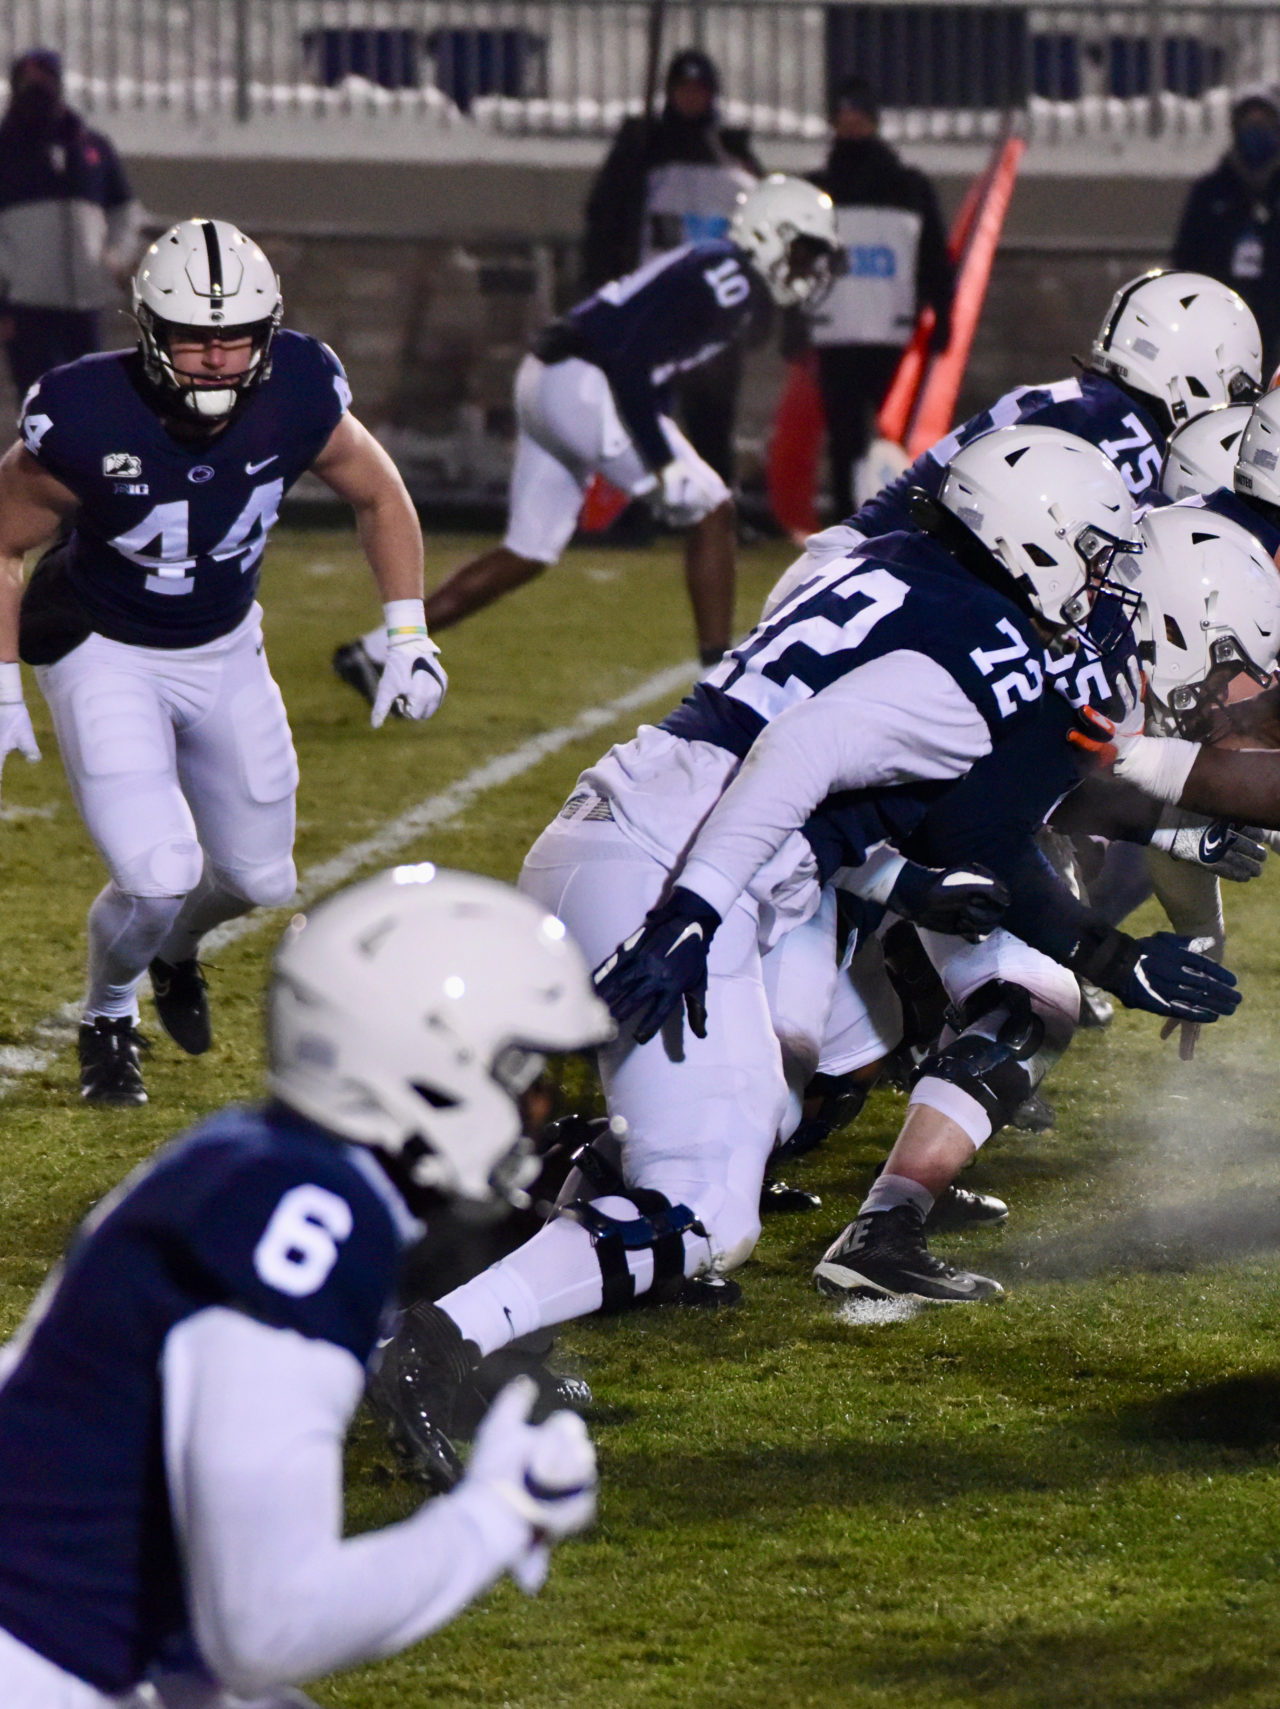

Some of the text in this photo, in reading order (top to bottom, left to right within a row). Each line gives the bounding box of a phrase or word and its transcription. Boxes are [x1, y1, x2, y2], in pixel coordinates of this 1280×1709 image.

[703, 257, 750, 308] 10
[1098, 411, 1164, 495] 75
[106, 476, 285, 596] 44
[969, 616, 1046, 719] 72
[253, 1182, 354, 1298] 6
